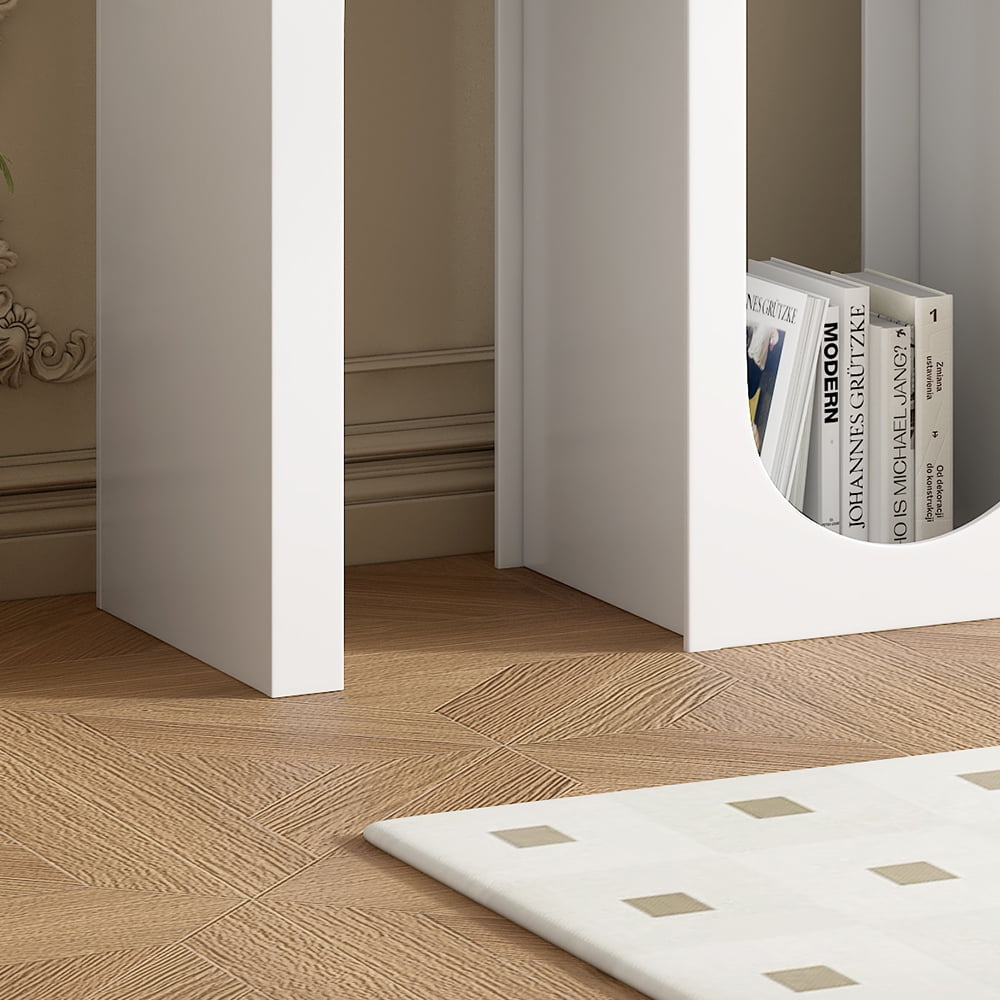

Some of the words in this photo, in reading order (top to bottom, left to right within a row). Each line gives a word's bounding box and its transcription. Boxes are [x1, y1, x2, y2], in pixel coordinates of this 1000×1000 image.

[929, 308, 938, 322] 1
[823, 322, 839, 424] MODERN
[847, 304, 866, 410] GRÜTZKE
[893, 345, 908, 406] JANG?
[926, 355, 934, 400] ustawienia
[849, 412, 866, 529] JOHANNES
[893, 407, 908, 496] MICHAEL
[926, 463, 934, 474] do
[936, 464, 944, 477] Od
[893, 499, 908, 518] IS
[925, 475, 934, 523] konstrukcji
[935, 479, 944, 519] dekoracji
